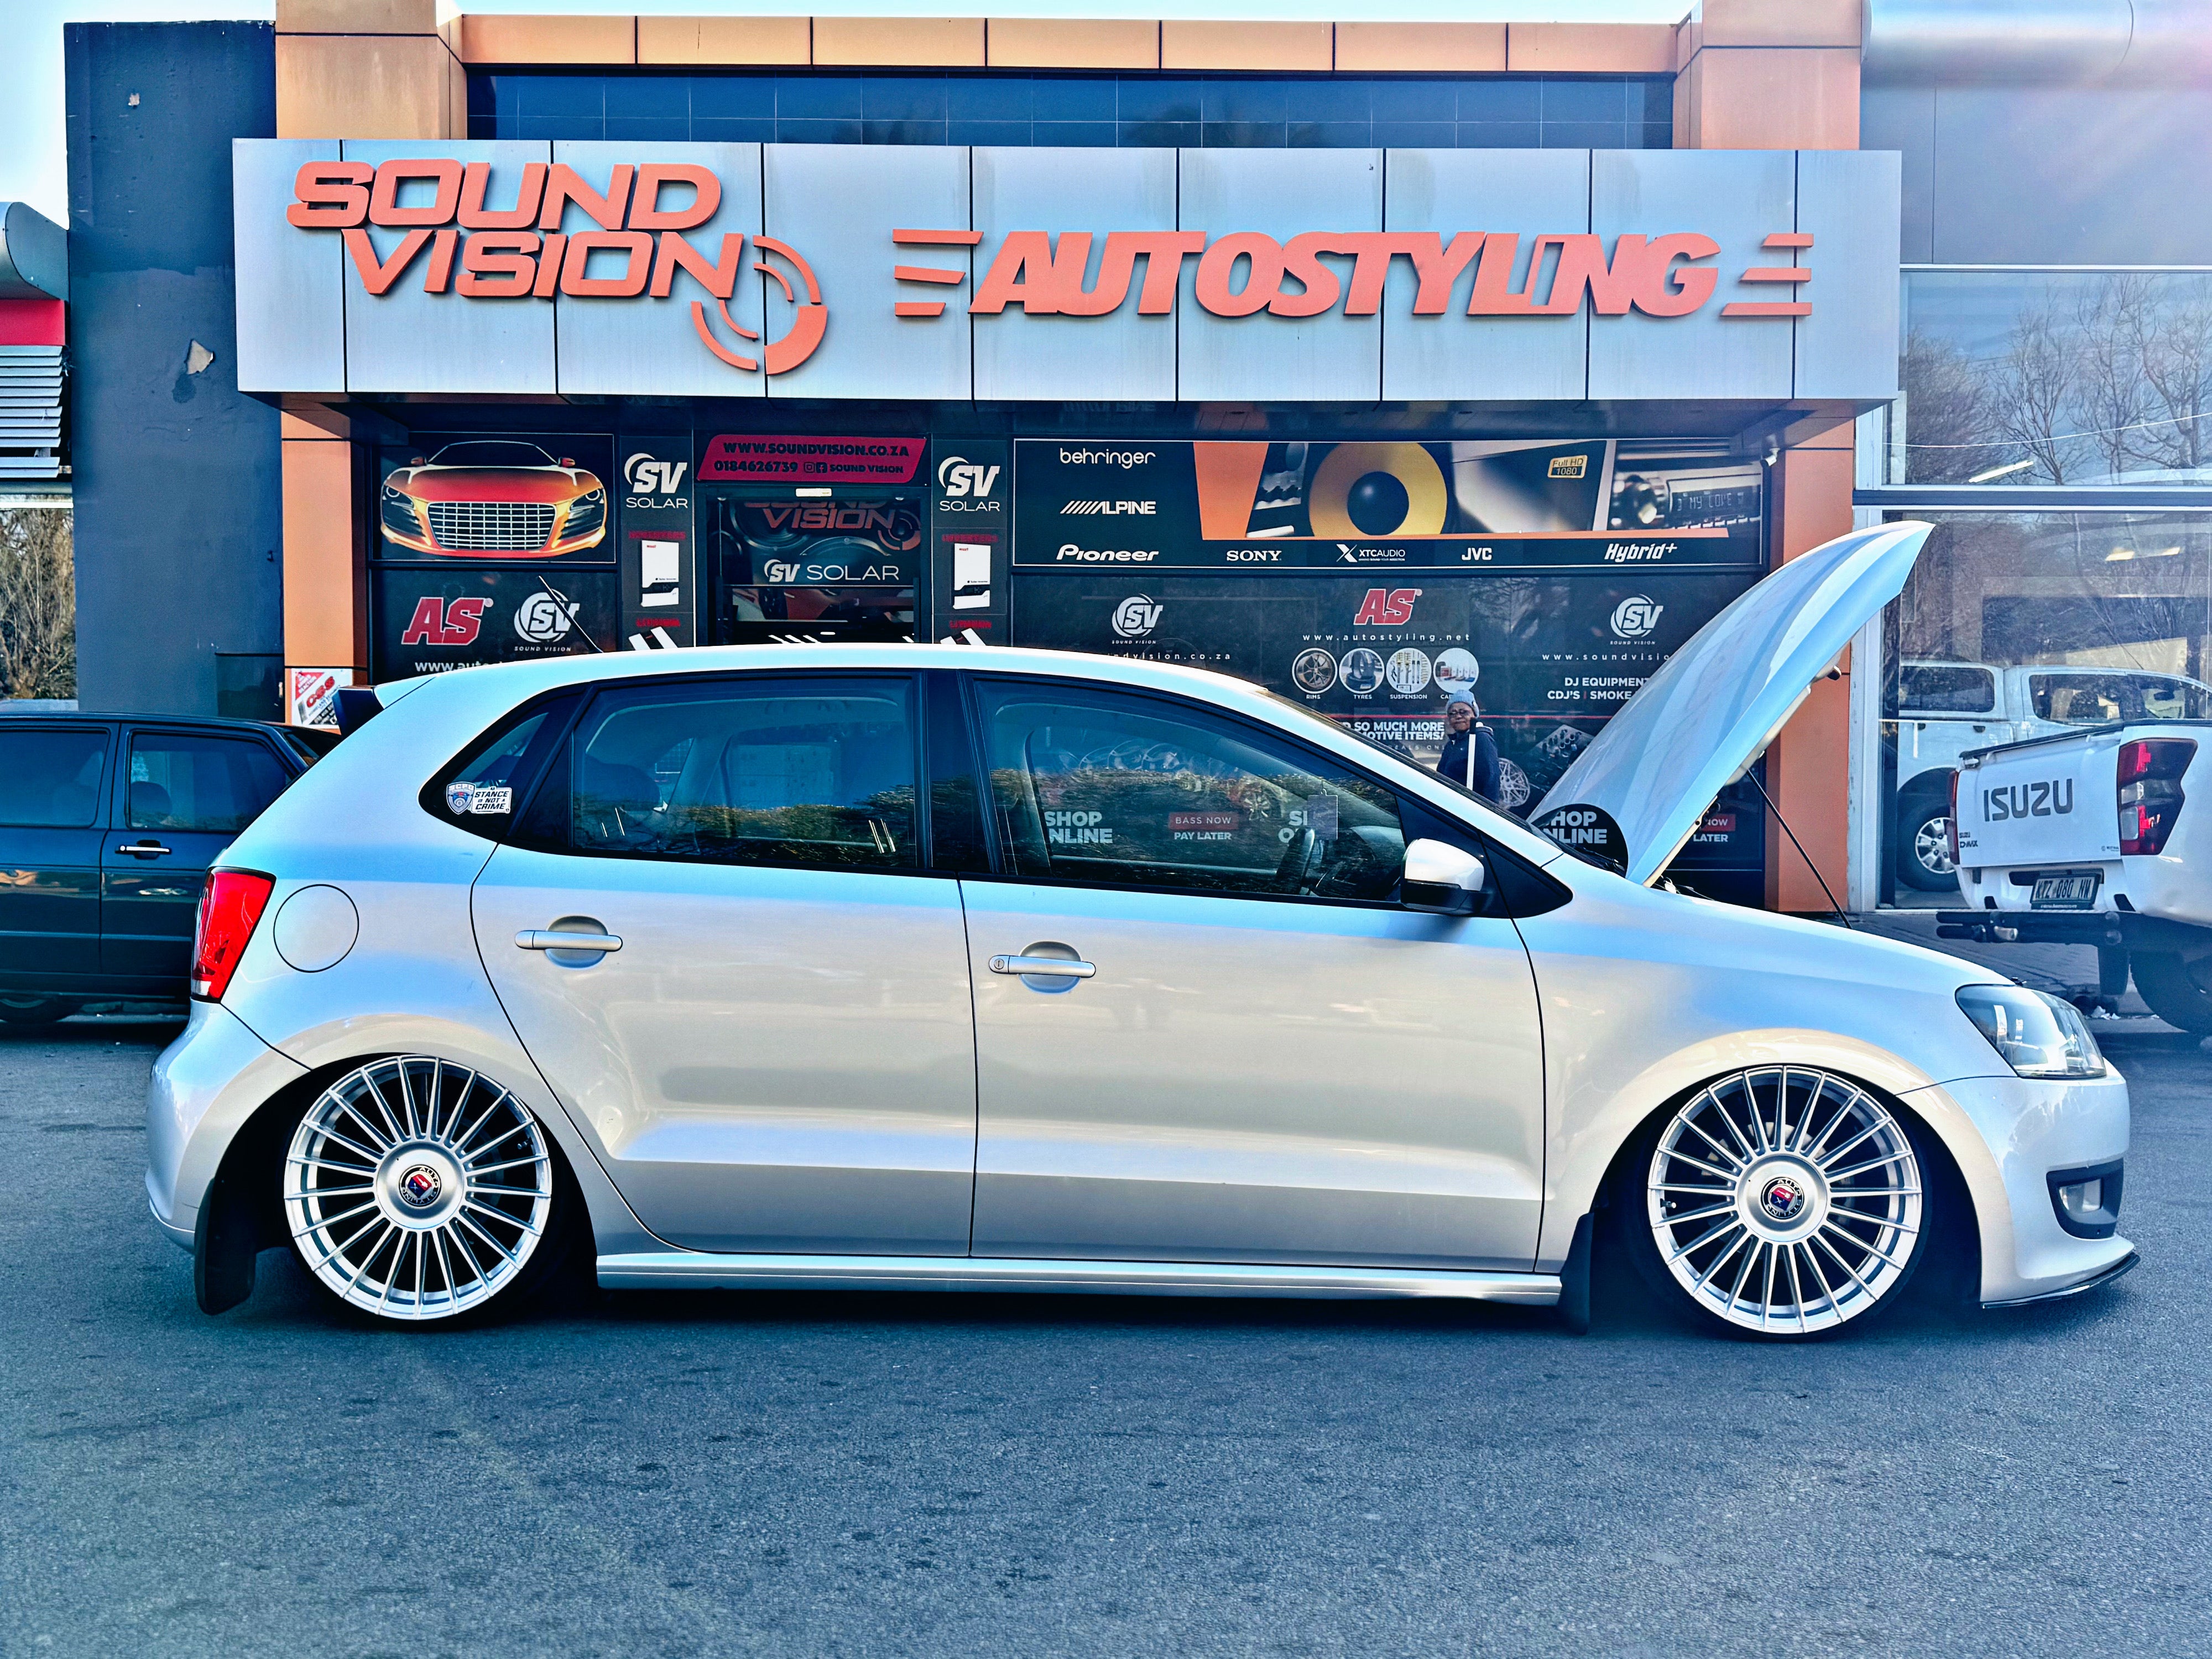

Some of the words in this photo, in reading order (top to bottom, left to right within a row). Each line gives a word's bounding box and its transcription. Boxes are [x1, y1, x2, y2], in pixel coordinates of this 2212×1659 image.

[287, 158, 722, 231] SOUND
[341, 228, 744, 299] VISION
[968, 229, 1722, 318] AUTOSTYLING
[723, 442, 909, 456] WWW.SOUNDVISION.CO.ZA
[1060, 448, 1156, 469] behringer
[1571, 458, 1584, 466] HD
[714, 460, 798, 472] 0184626739
[830, 464, 866, 473] SOUND
[868, 464, 904, 474] VISION
[1556, 467, 1577, 475] 1080
[633, 461, 687, 493] SV
[946, 465, 1000, 497] SV
[625, 497, 688, 509] SOLAR
[939, 500, 1000, 512] SOLAR
[1078, 500, 1156, 514] ALPINE
[762, 508, 895, 529] VISION
[1056, 544, 1159, 562] Pioneer
[1226, 550, 1280, 561] SONY
[1462, 547, 1492, 561] JVC
[1604, 542, 1677, 562] Hybrid+
[769, 563, 800, 582] SV
[806, 565, 899, 581] SOLAR
[1353, 588, 1416, 625] AS
[401, 597, 488, 645] AS
[528, 602, 580, 633] SV
[1123, 604, 1164, 629] SV
[1624, 604, 1664, 629] SV
[1302, 633, 1470, 642] www.autostyling.net
[1564, 677, 1579, 686] DJ
[1590, 691, 1632, 700] SMOKE
[1354, 722, 1370, 731] SO
[1373, 722, 1407, 731] MUCH
[1411, 722, 1444, 731] MORE
[1405, 731, 1444, 740] ITEMS!
[1984, 778, 2074, 822] ISUZU
[1044, 811, 1102, 826] SHOP
[1551, 811, 1597, 826] HOP
[1048, 828, 1113, 843] NLINE
[1174, 832, 1194, 840] PAY
[1197, 832, 1232, 840] LATER
[1543, 828, 1608, 844] NLINE
[1693, 834, 1729, 842] LATER
